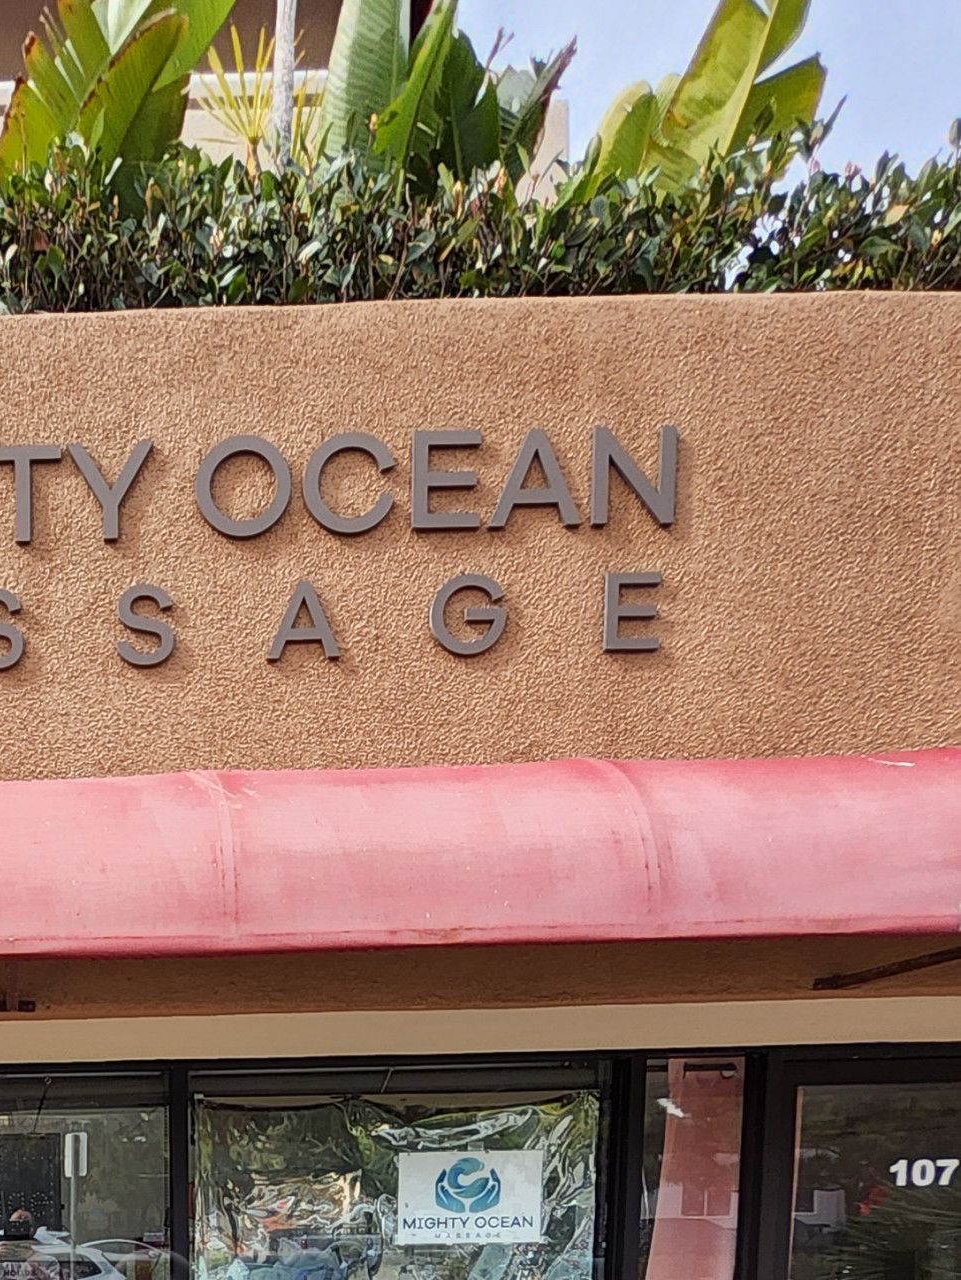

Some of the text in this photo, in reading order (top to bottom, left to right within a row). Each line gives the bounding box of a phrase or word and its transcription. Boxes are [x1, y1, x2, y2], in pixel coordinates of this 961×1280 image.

[194, 425, 680, 540] OCEAN
[889, 1159, 960, 1187] 107
[402, 1215, 534, 1230] MIGHTY OCEAN
